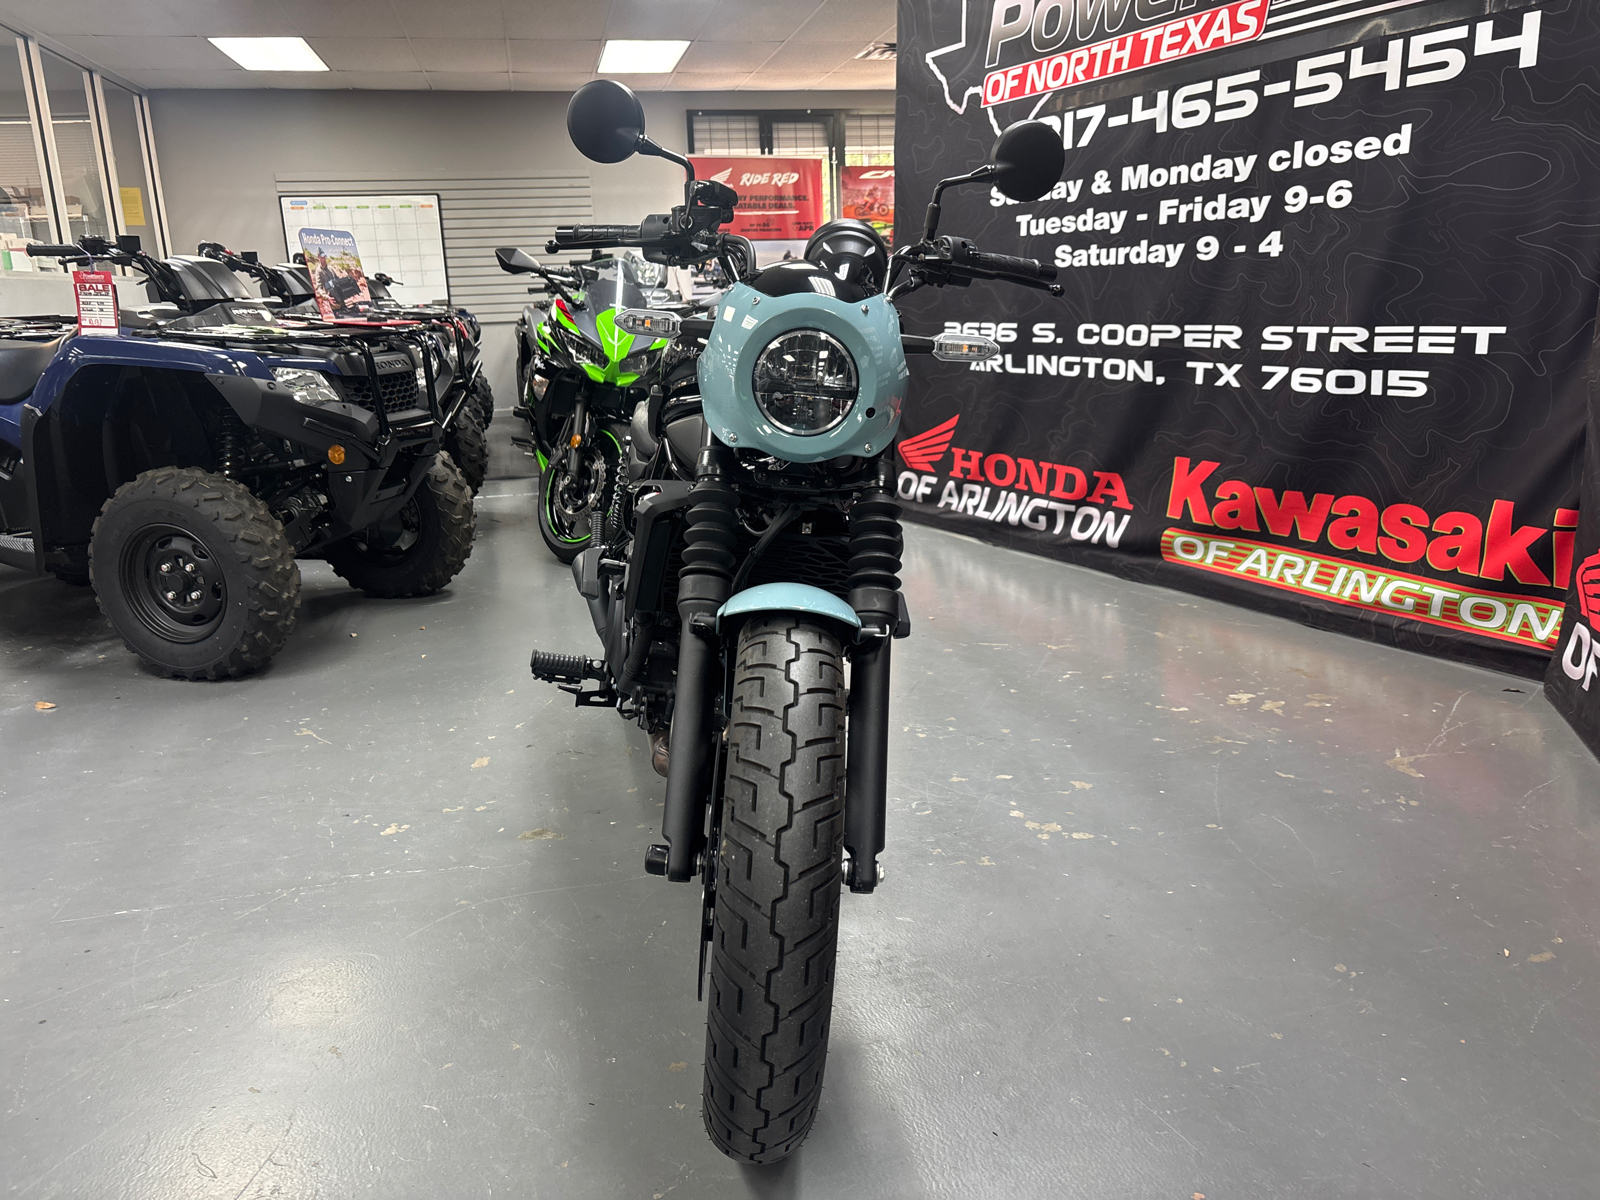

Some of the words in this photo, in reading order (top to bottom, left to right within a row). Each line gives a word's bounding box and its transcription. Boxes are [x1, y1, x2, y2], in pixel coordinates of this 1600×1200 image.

[985, 65, 1023, 103] OF
[1024, 40, 1134, 95] NORTH
[1140, 2, 1260, 65] TEXAS
[1038, 10, 1541, 150] 17-465-5454
[739, 172, 771, 187] RIDE
[771, 171, 800, 188] RED
[990, 178, 1084, 208] Say
[1091, 169, 1113, 195] &
[1121, 155, 1258, 191] Monday
[1268, 124, 1413, 173] closed
[301, 232, 321, 245] Honda
[321, 233, 354, 247] Pro-Connect
[1016, 207, 1128, 237] Tuesday
[1159, 193, 1272, 225] Friday
[1284, 179, 1353, 214] 9-6
[1053, 239, 1186, 268] Saturday
[1196, 235, 1220, 261] 9
[1259, 230, 1284, 258] 4
[944, 321, 1018, 343] 3636
[1032, 322, 1064, 344] S.
[1076, 323, 1242, 350] COOPER
[1260, 325, 1507, 356] STREET
[970, 353, 1166, 386] ARLINGTON,
[1186, 361, 1243, 388] TX
[1262, 366, 1430, 398] 76015
[897, 471, 938, 503] OF
[937, 480, 1131, 549] ARLINGTON
[949, 447, 1135, 511] HONDA
[1166, 456, 1580, 590] Kawasaki
[1172, 533, 1236, 566] OF
[1237, 547, 1562, 642] ARLINGTON
